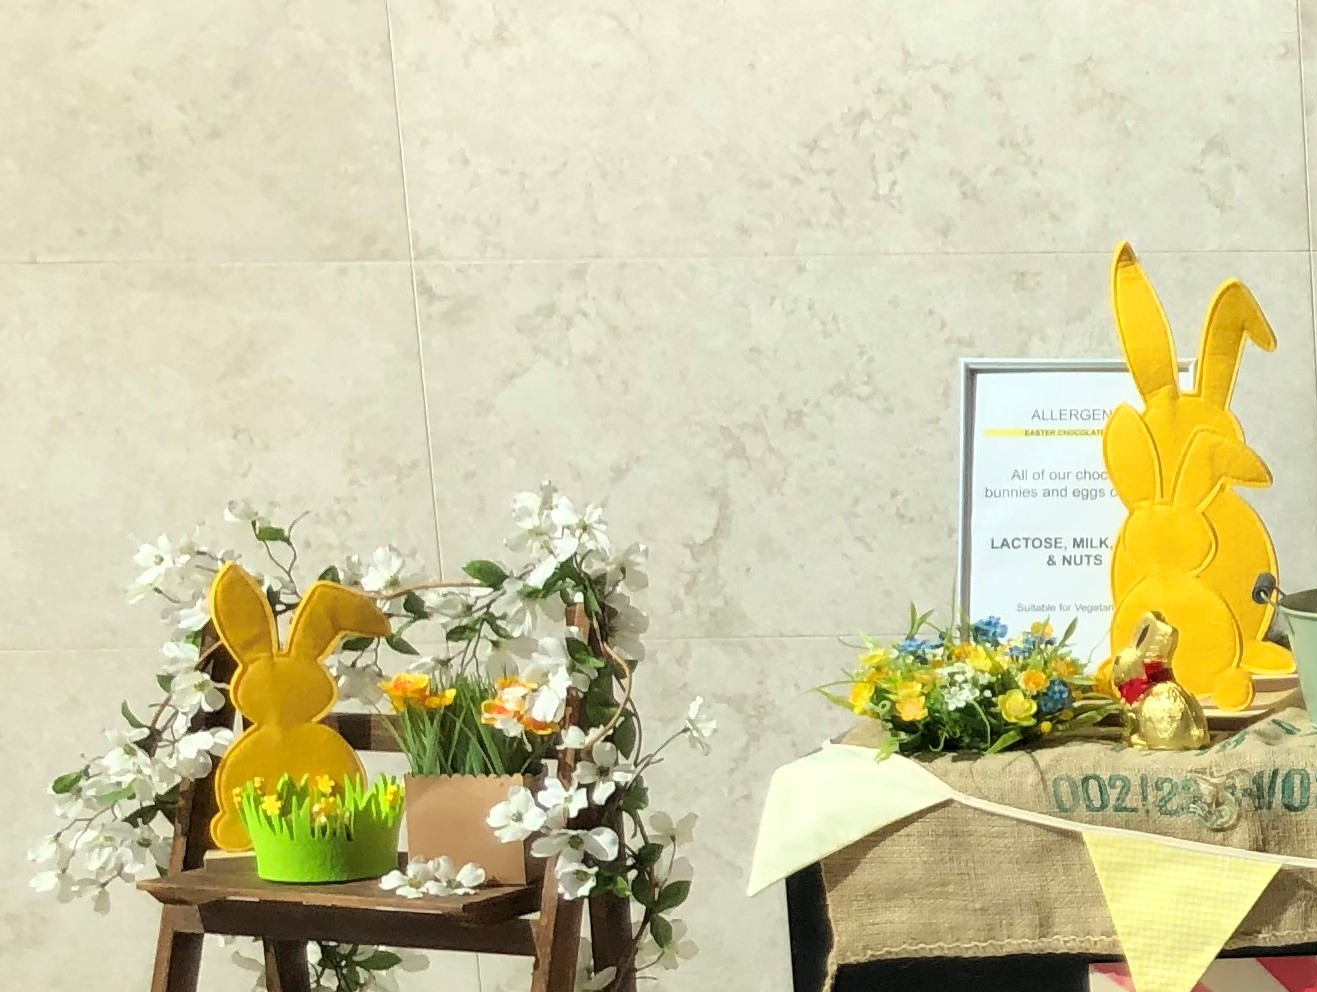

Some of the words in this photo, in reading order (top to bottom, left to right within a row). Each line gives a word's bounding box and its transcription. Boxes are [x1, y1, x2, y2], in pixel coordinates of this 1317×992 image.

[1024, 429, 1056, 437] EASTER
[1011, 469, 1028, 481] All
[1032, 468, 1046, 481] of
[1049, 471, 1072, 481] our
[984, 486, 1039, 498] bunnies
[1042, 486, 1068, 498] and
[1072, 487, 1106, 501] eggs
[990, 536, 1068, 551] LACTOSE,
[1072, 536, 1114, 550] MILK,
[1046, 554, 1057, 566] &
[1062, 554, 1103, 566] NUTS
[1016, 602, 1056, 613] Suitable
[1059, 602, 1071, 612] for
